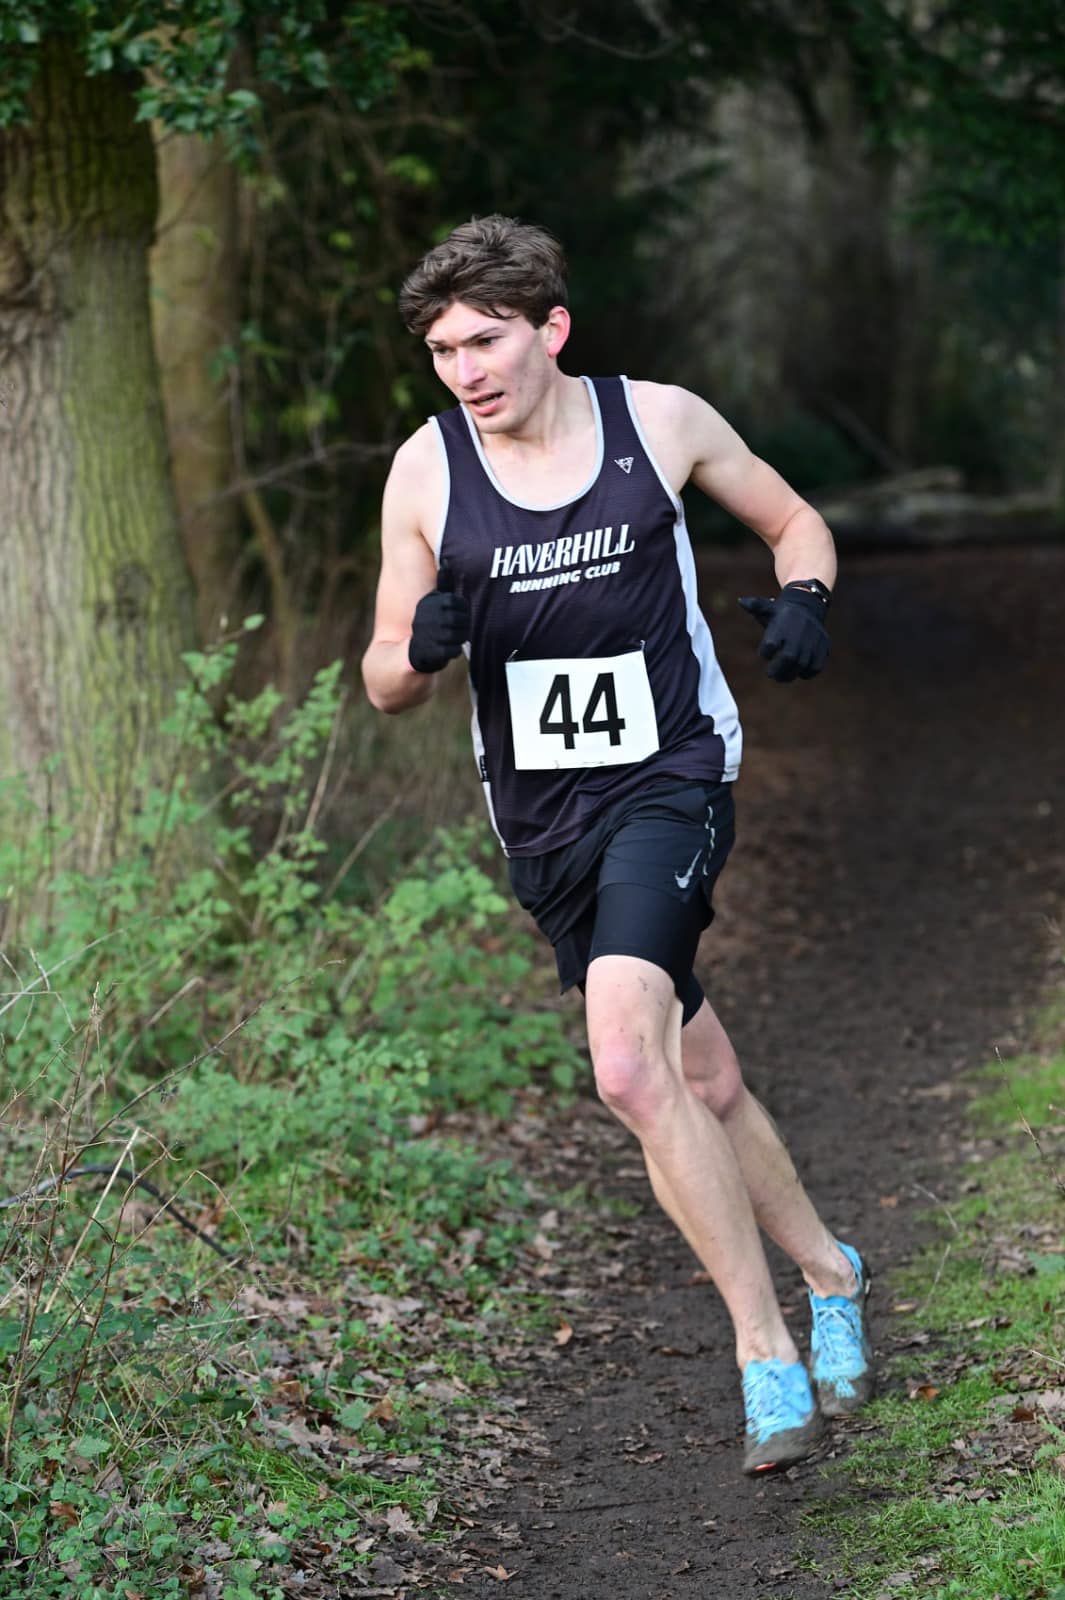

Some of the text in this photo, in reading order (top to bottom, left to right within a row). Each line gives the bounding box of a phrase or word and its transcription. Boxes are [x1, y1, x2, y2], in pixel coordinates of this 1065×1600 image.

[490, 524, 635, 578] HAVERHILL
[509, 561, 621, 593] RUNNING CLUB
[539, 672, 626, 750] 44
